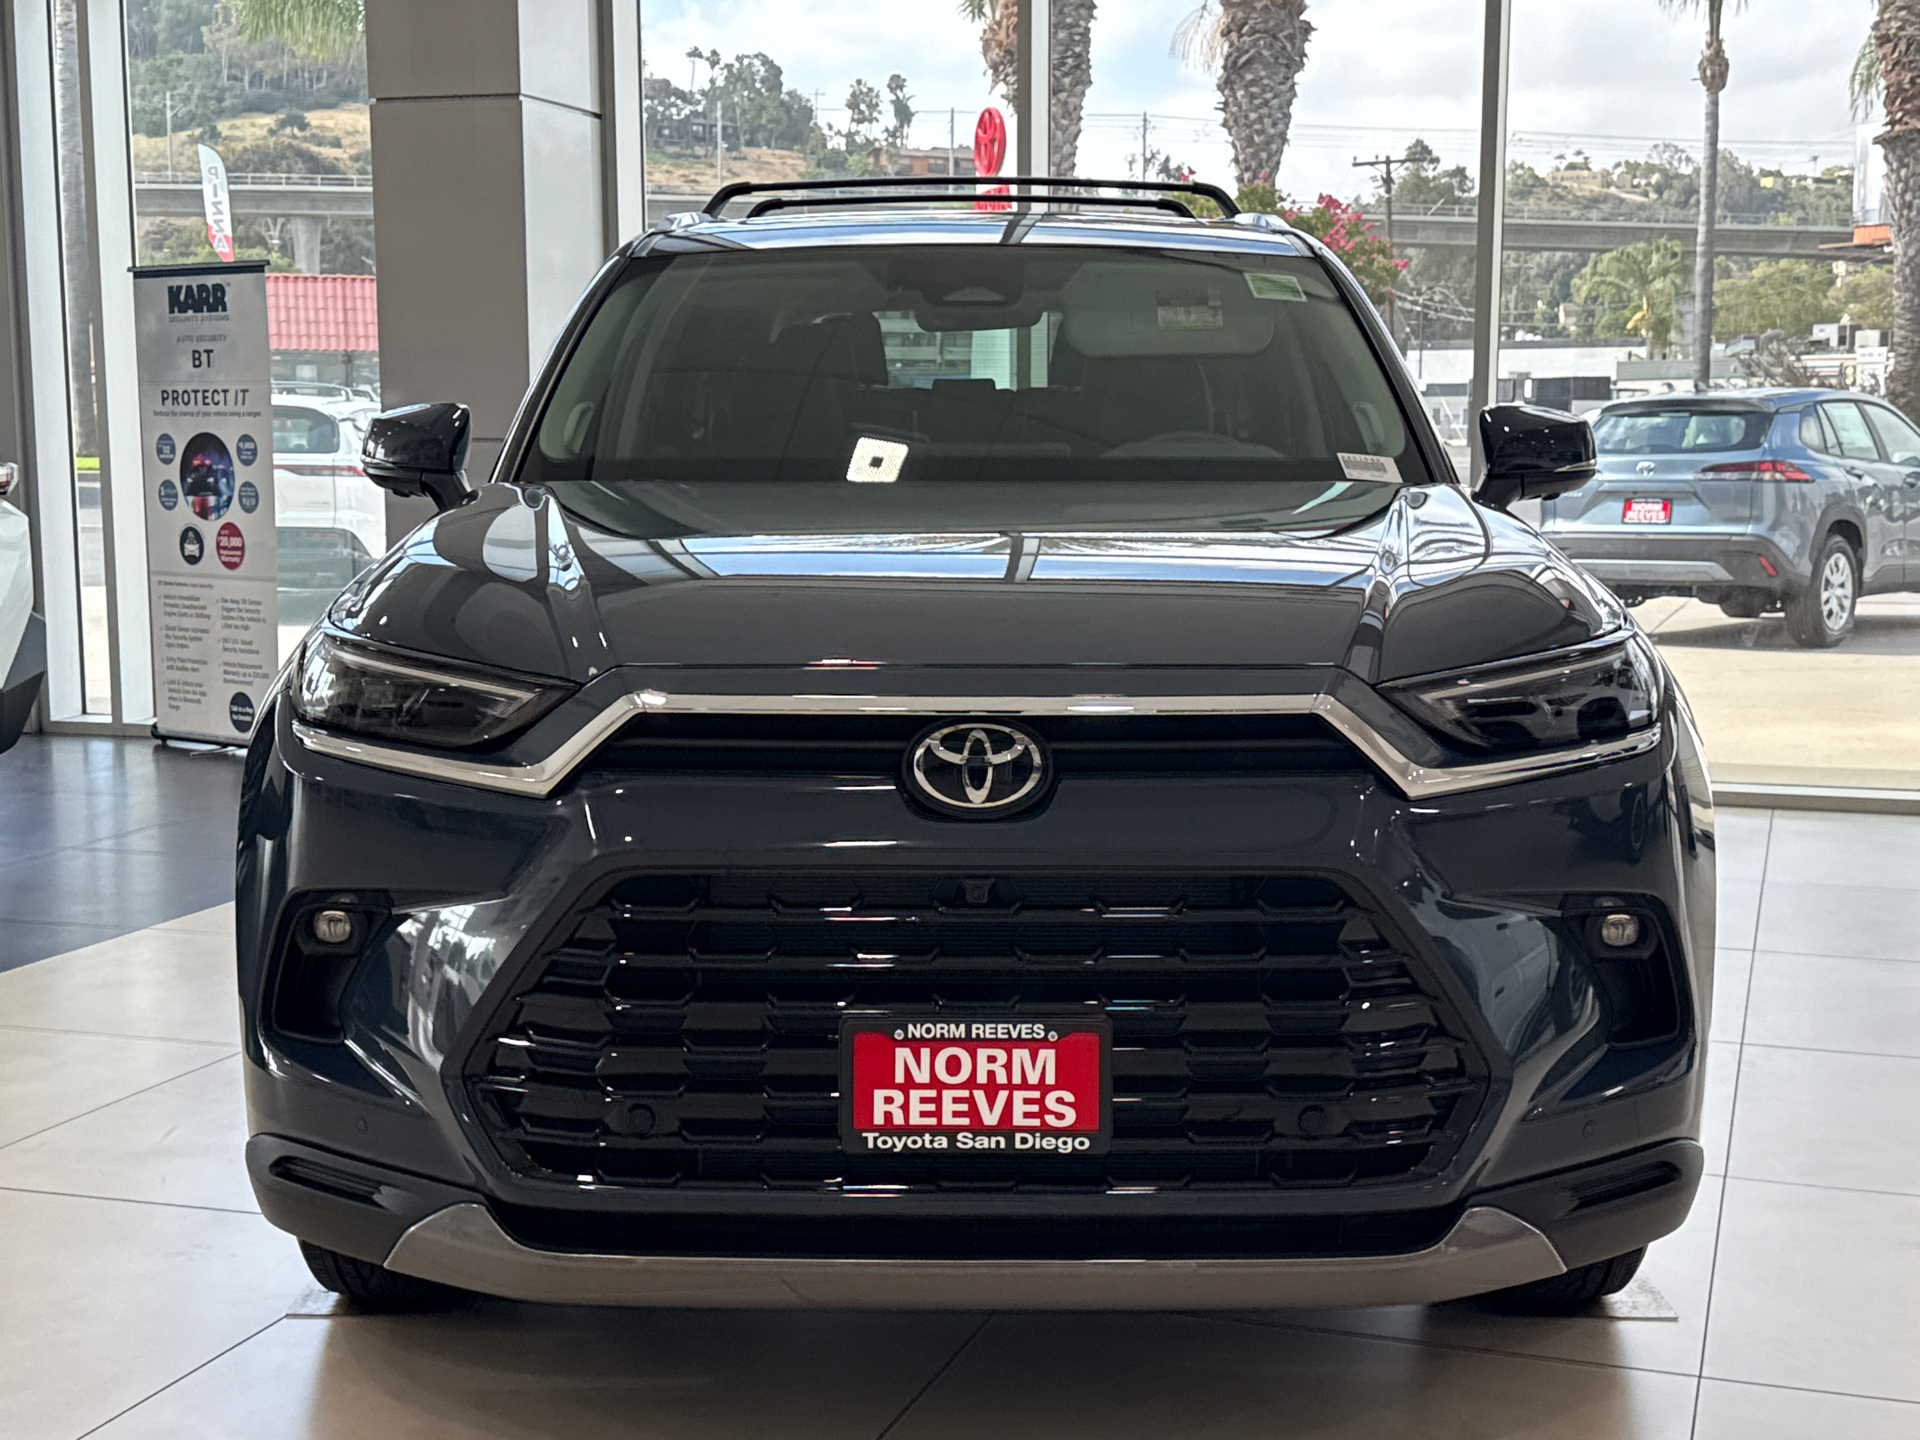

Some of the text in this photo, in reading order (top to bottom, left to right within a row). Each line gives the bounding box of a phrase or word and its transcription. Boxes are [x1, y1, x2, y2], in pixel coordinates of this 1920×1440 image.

[168, 283, 227, 314] KARR
[192, 349, 214, 368] BT
[161, 389, 250, 406] PROTECT IT
[908, 1023, 1045, 1039] NORM REEVES
[895, 1047, 1056, 1085] NORM
[873, 1089, 1077, 1128] REEVES
[862, 1132, 1090, 1154] Toyota San Diego
